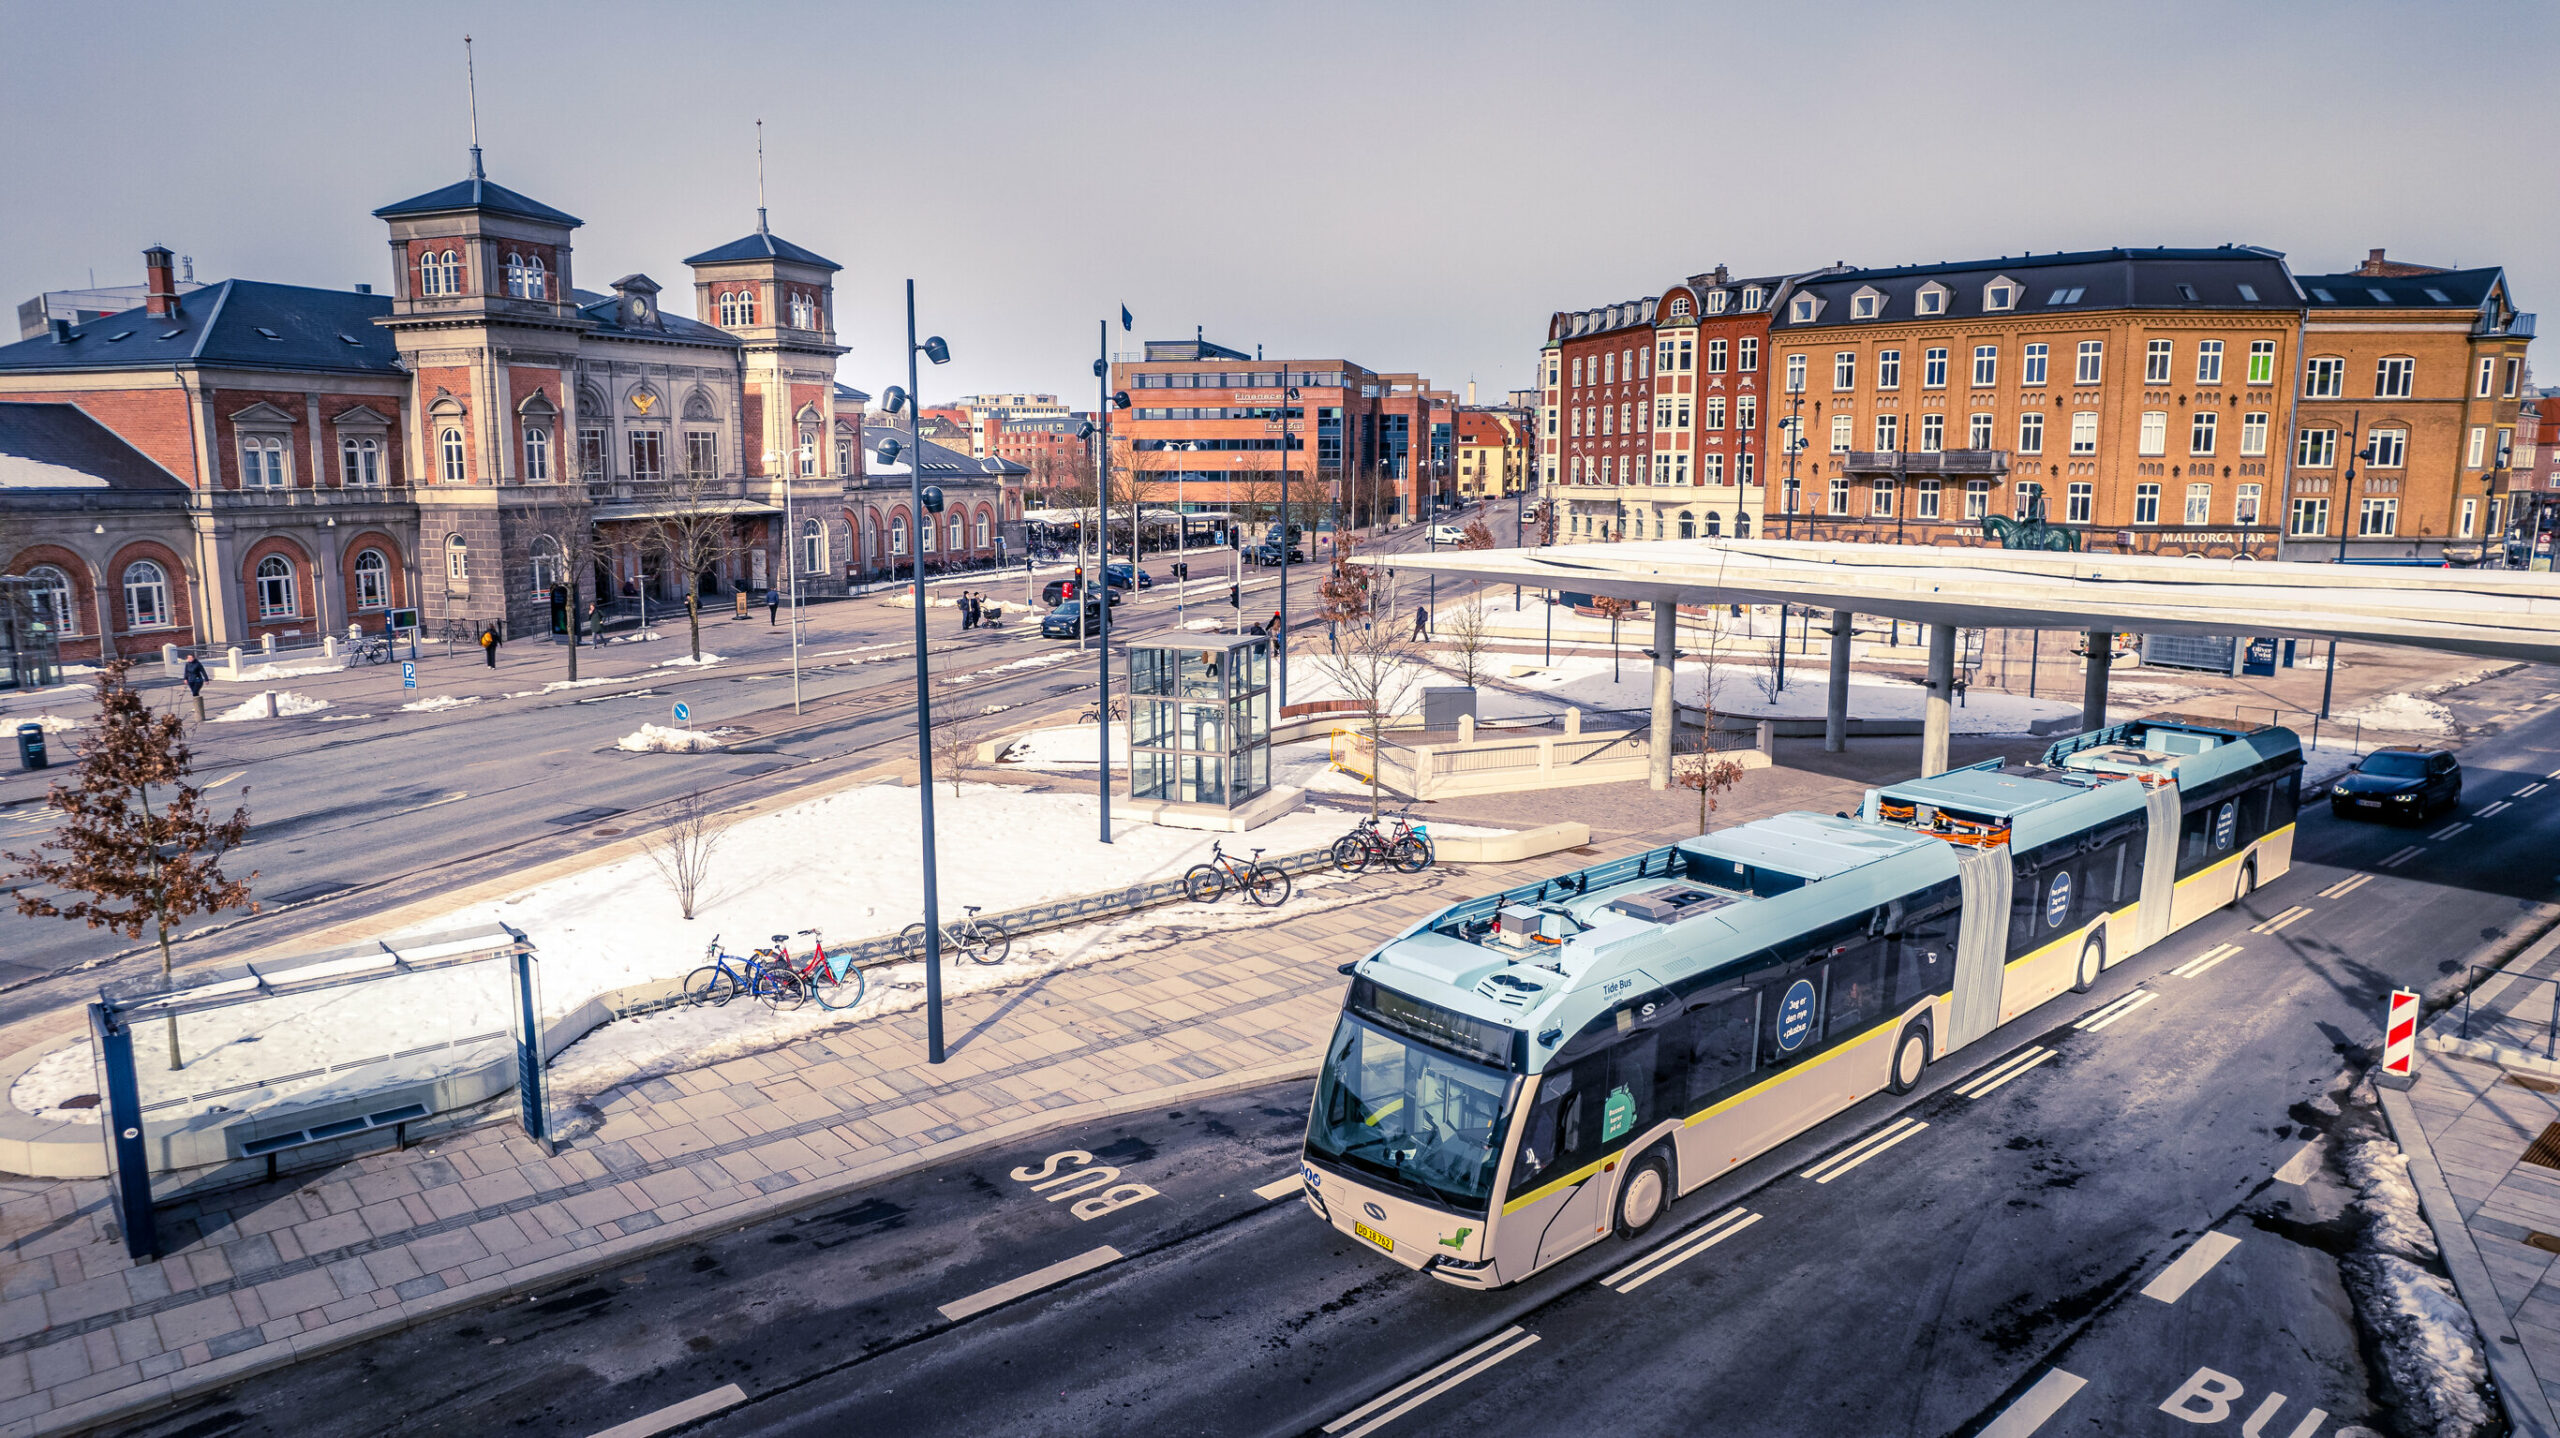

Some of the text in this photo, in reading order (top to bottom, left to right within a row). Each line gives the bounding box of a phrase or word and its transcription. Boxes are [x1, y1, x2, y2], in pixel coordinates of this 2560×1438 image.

[2161, 533, 2234, 543] MALLORCA
[1603, 979, 1632, 995] Tide Bus
[1789, 996, 1807, 1010] Jeg er
[1786, 1014, 1796, 1024] den
[1010, 1150, 1160, 1221] BUS
[1377, 1235, 1391, 1248] 762
